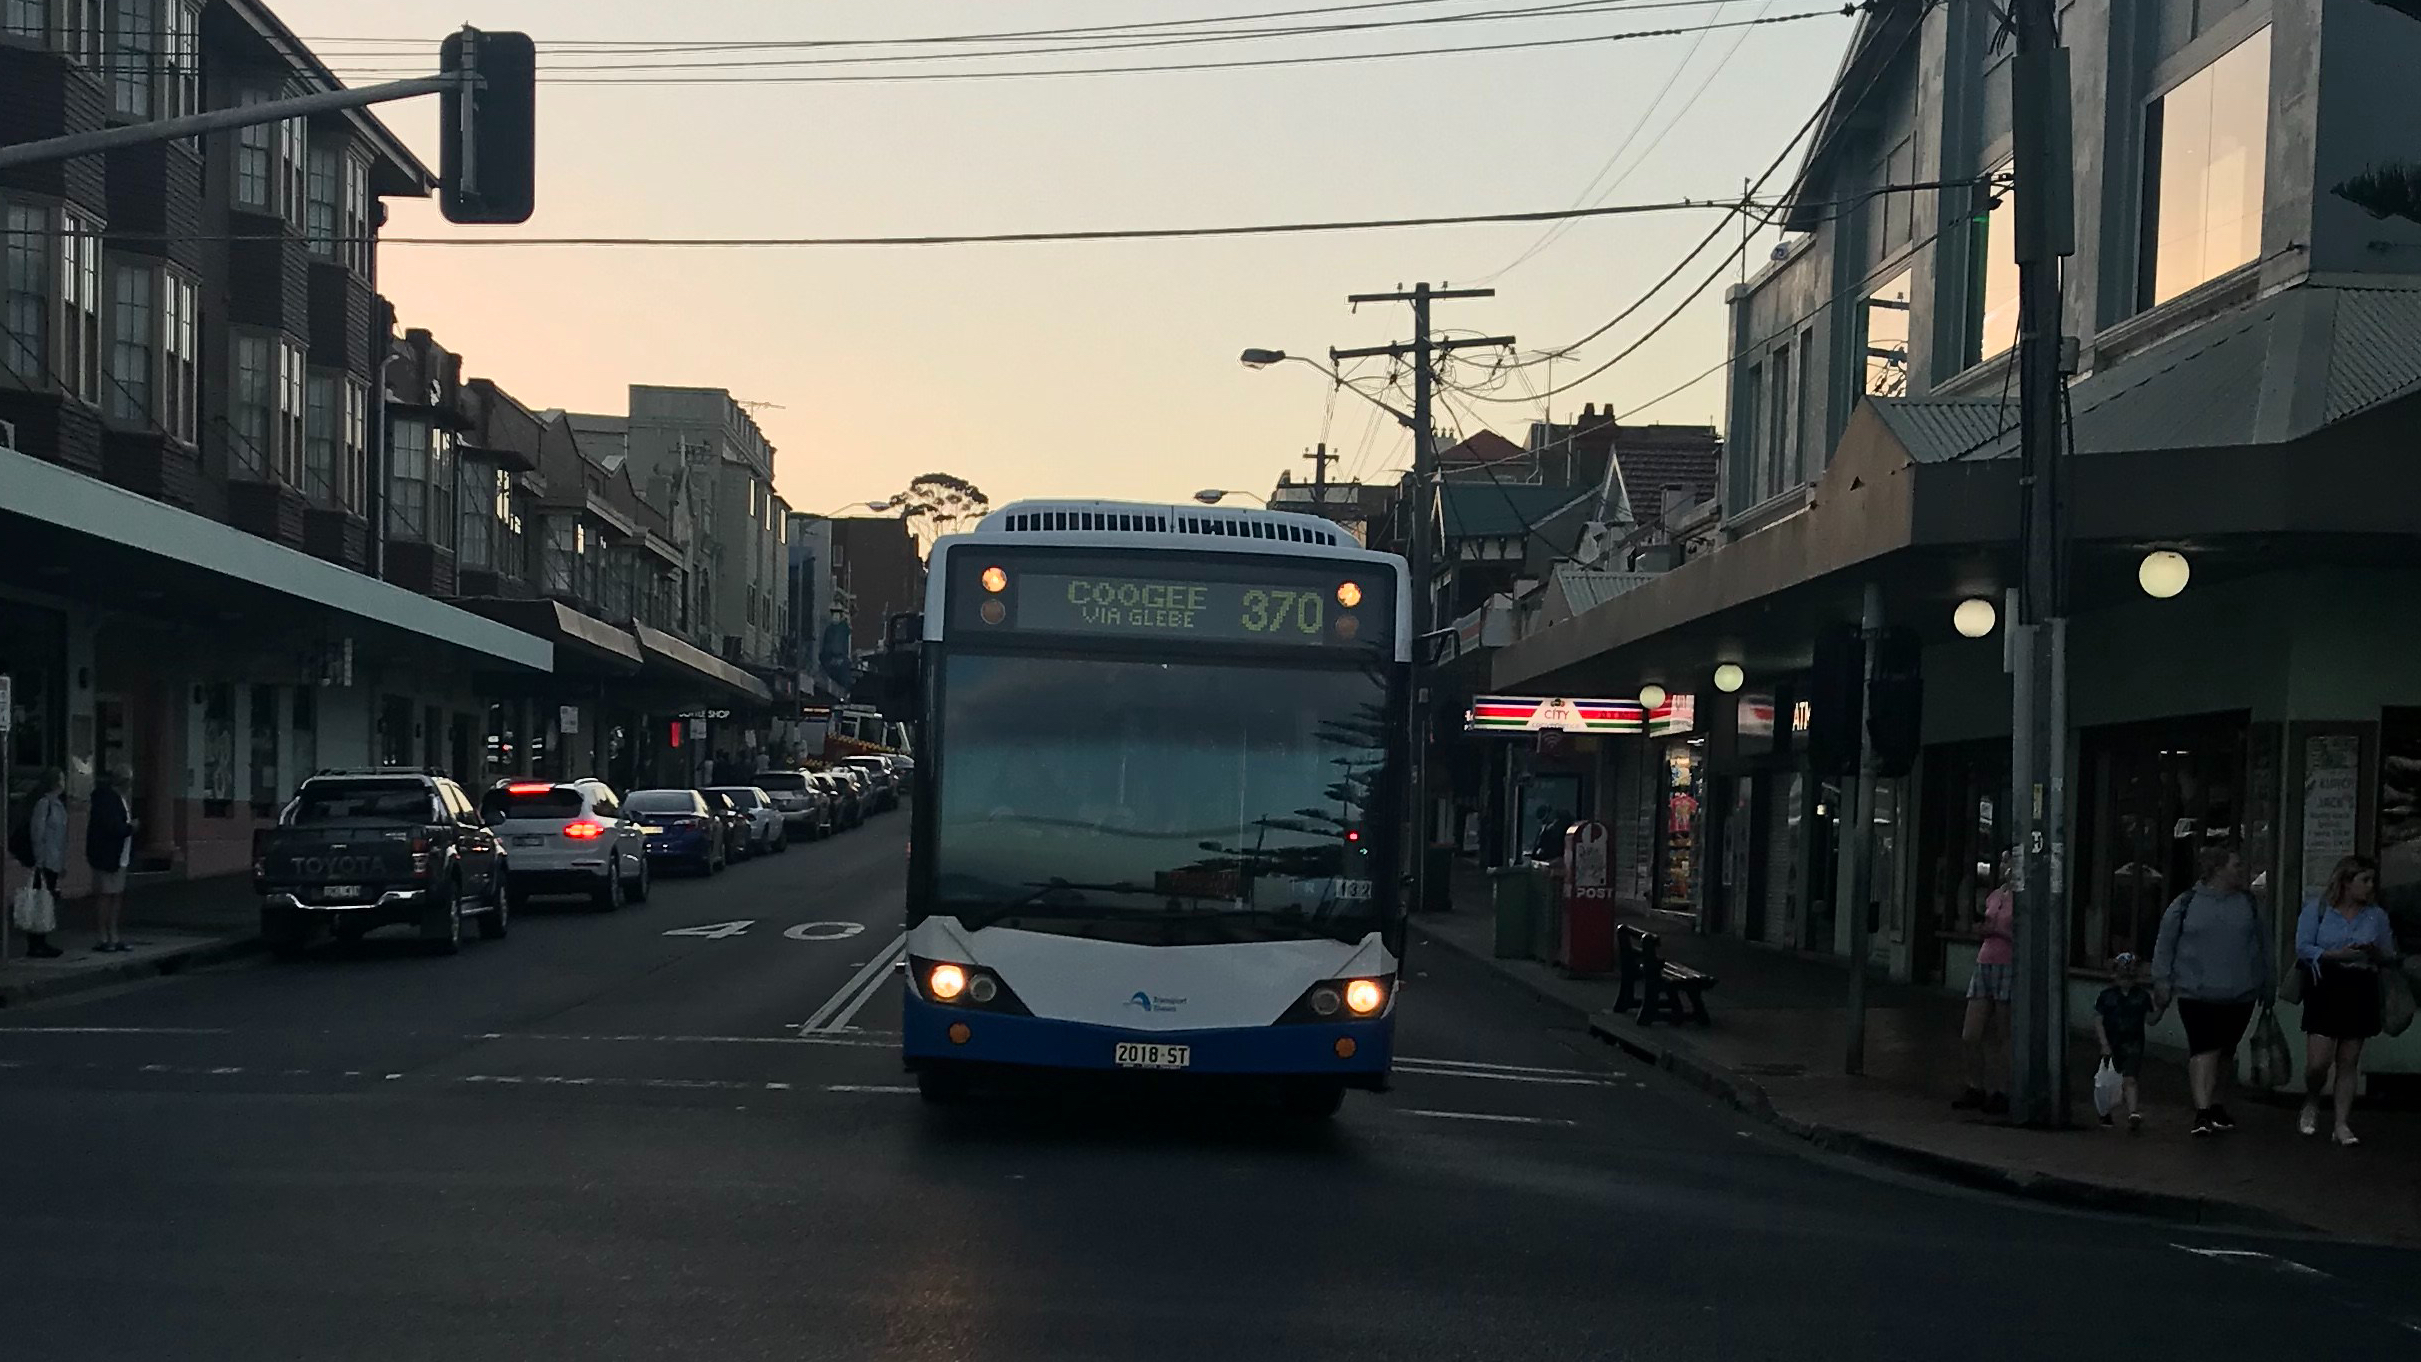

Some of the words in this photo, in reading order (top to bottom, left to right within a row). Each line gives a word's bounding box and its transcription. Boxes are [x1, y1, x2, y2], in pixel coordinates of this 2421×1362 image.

[1067, 580, 1208, 610] COOGEE
[1082, 606, 1121, 625] VIA
[1128, 608, 1195, 628] GLEBE
[1241, 589, 1325, 635] 370
[707, 708, 731, 719] SHOP
[1544, 708, 1569, 721] CITY
[291, 855, 387, 875] TOYOTA
[1576, 887, 1614, 900] POST
